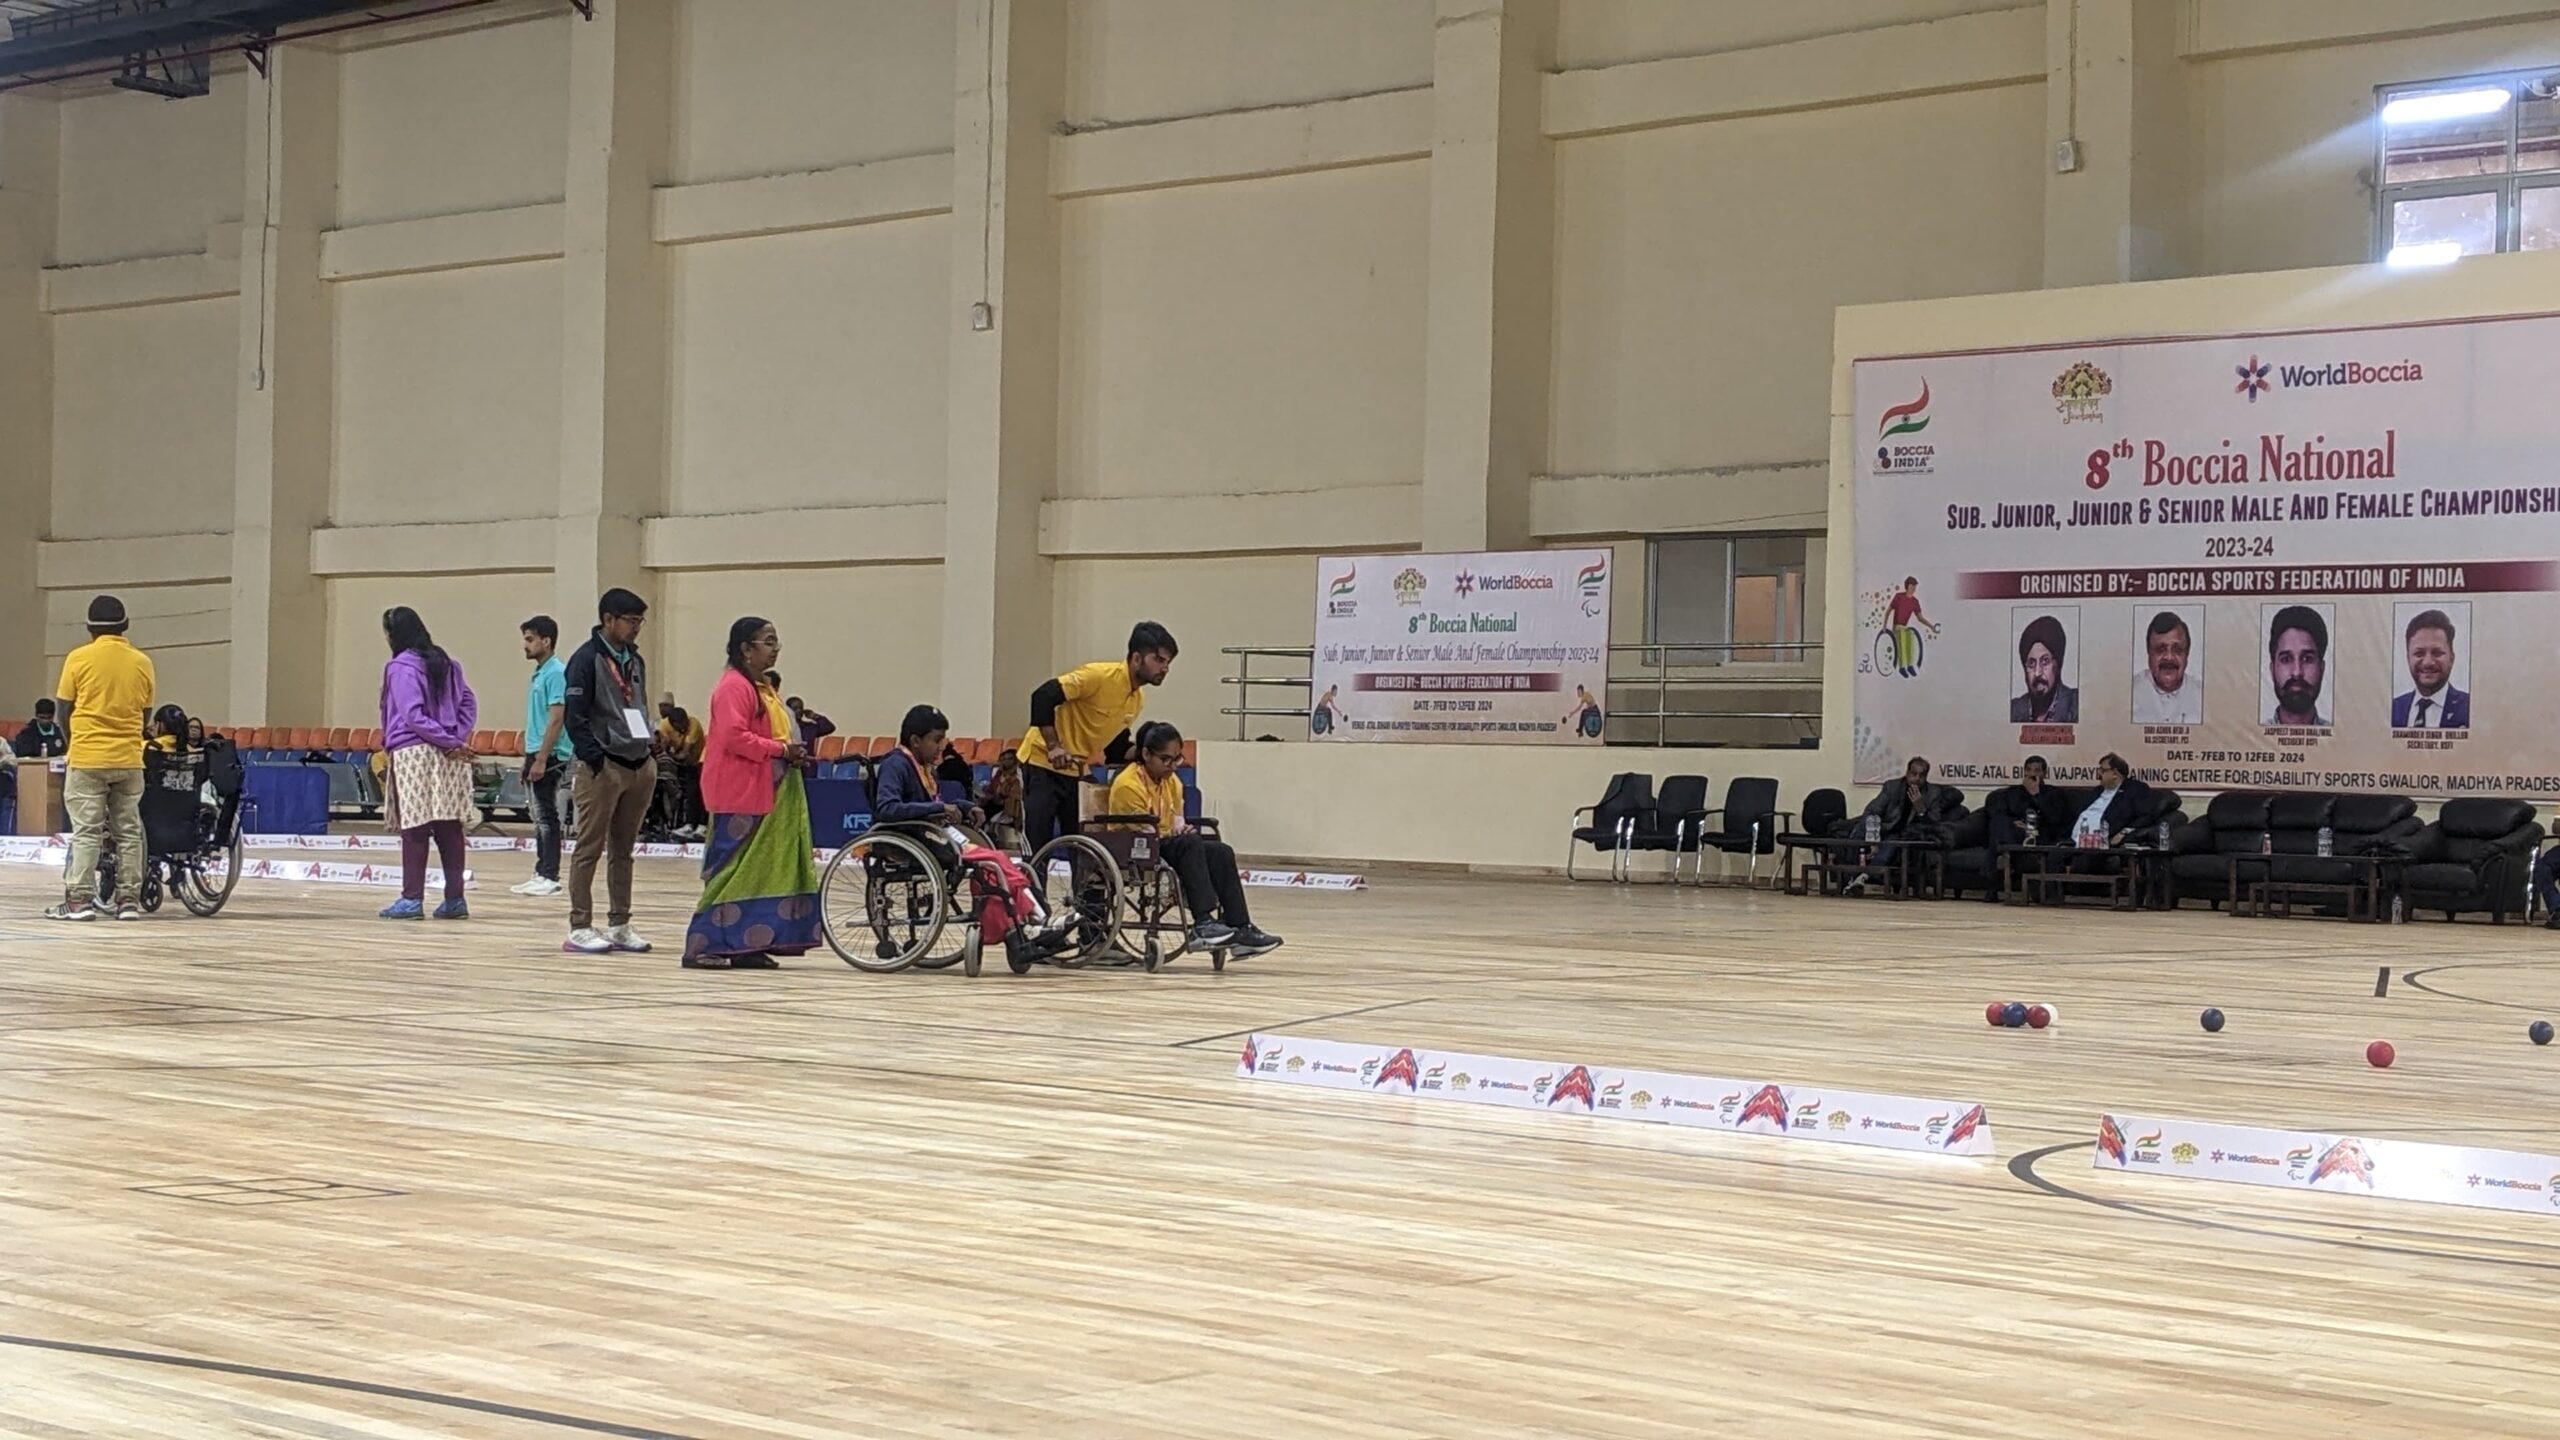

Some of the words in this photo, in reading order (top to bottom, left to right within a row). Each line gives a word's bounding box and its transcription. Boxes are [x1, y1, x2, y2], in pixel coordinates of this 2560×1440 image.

[2280, 360, 2423, 388] WorldBoccia
[1894, 446, 1934, 456] BOCCIA
[2085, 438, 2134, 489] 8th
[2143, 439, 2249, 487] Boccia
[2259, 430, 2395, 482] National
[1992, 502, 2061, 531] JUNIOR,
[2067, 500, 2132, 526] JUNIOR
[2139, 498, 2152, 524] &
[2158, 497, 2224, 524] SENIOR
[2231, 495, 2283, 522] MALE
[2290, 493, 2328, 521] AND
[2336, 492, 2414, 520] FEMALE
[2205, 536, 2274, 558] 2023-24
[1479, 575, 1553, 590] WorldBoccia
[2020, 573, 2102, 594] ORGINISED
[2147, 572, 2206, 592] BOCCIA
[2212, 571, 2275, 591] SPORTS
[2280, 569, 2383, 590] FEDERATION
[2389, 568, 2411, 589] OF
[2417, 567, 2465, 588] INDIA
[1429, 613, 1467, 633] Boccia
[1470, 612, 1517, 633] National
[1507, 641, 1566, 667] Championship
[1568, 647, 1599, 663] 2023-24
[1413, 701, 1429, 711] DATE
[1448, 701, 1457, 711] TO
[2167, 750, 2194, 761] DATE
[2201, 751, 2225, 762] 7FEB
[2228, 752, 2242, 762] TO
[2245, 752, 2275, 762] 12FEB
[2280, 752, 2304, 763] 2024
[1939, 764, 1980, 779] VENUE-
[1982, 765, 2010, 779] ATAL
[2173, 769, 2221, 783] CENTRE
[2224, 769, 2249, 783] FOR
[2254, 770, 2321, 785] DISABILITY
[2324, 772, 2375, 787] SPORTS
[2379, 773, 2442, 792] GWALIOR,
[2447, 775, 2502, 791] MADHYA
[1875, 1120, 1921, 1132] WorldBoccia
[2228, 1152, 2280, 1165] WorldBoccia
[2485, 1177, 2542, 1191] WorldBoccia
